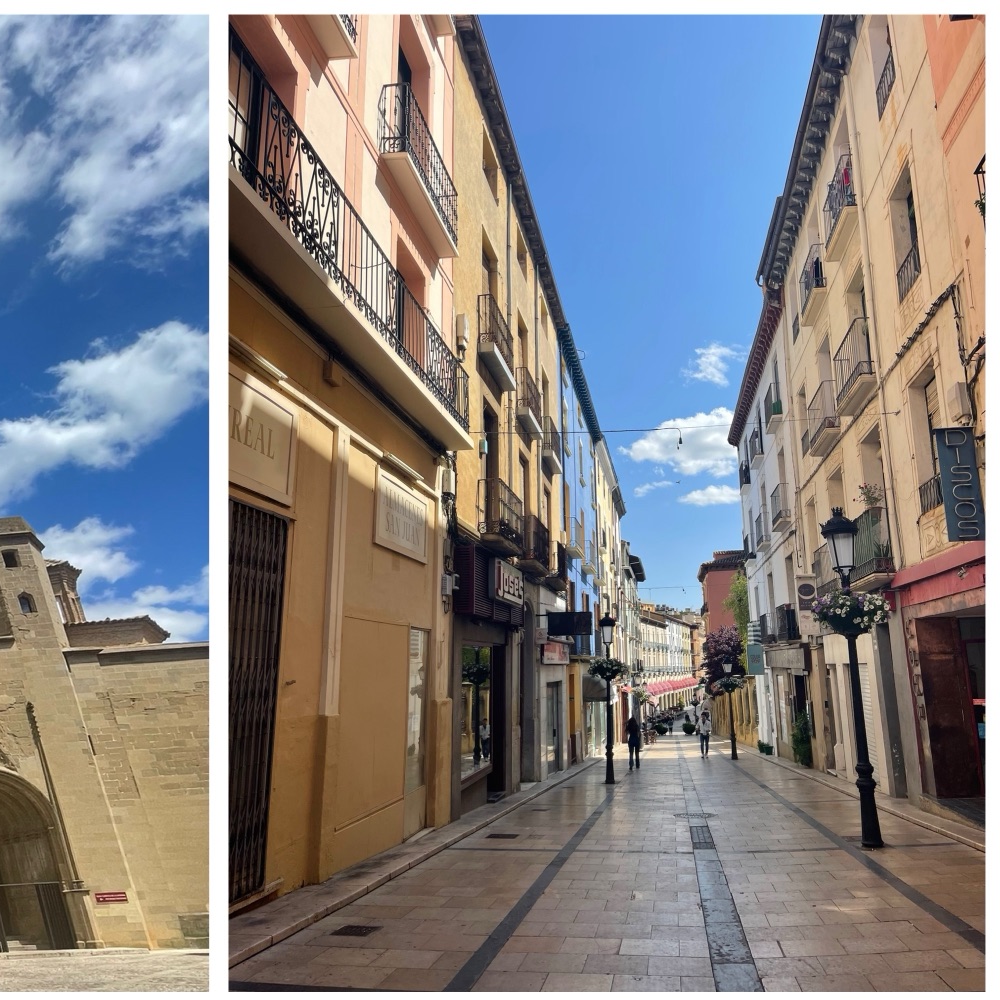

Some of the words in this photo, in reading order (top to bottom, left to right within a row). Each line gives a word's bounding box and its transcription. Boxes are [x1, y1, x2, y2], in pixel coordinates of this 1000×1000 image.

[229, 405, 275, 460] REAL
[382, 485, 424, 527] ALMACENES
[944, 429, 980, 538] DISCOS
[385, 511, 400, 537] SAN
[401, 520, 420, 547] JUAN
